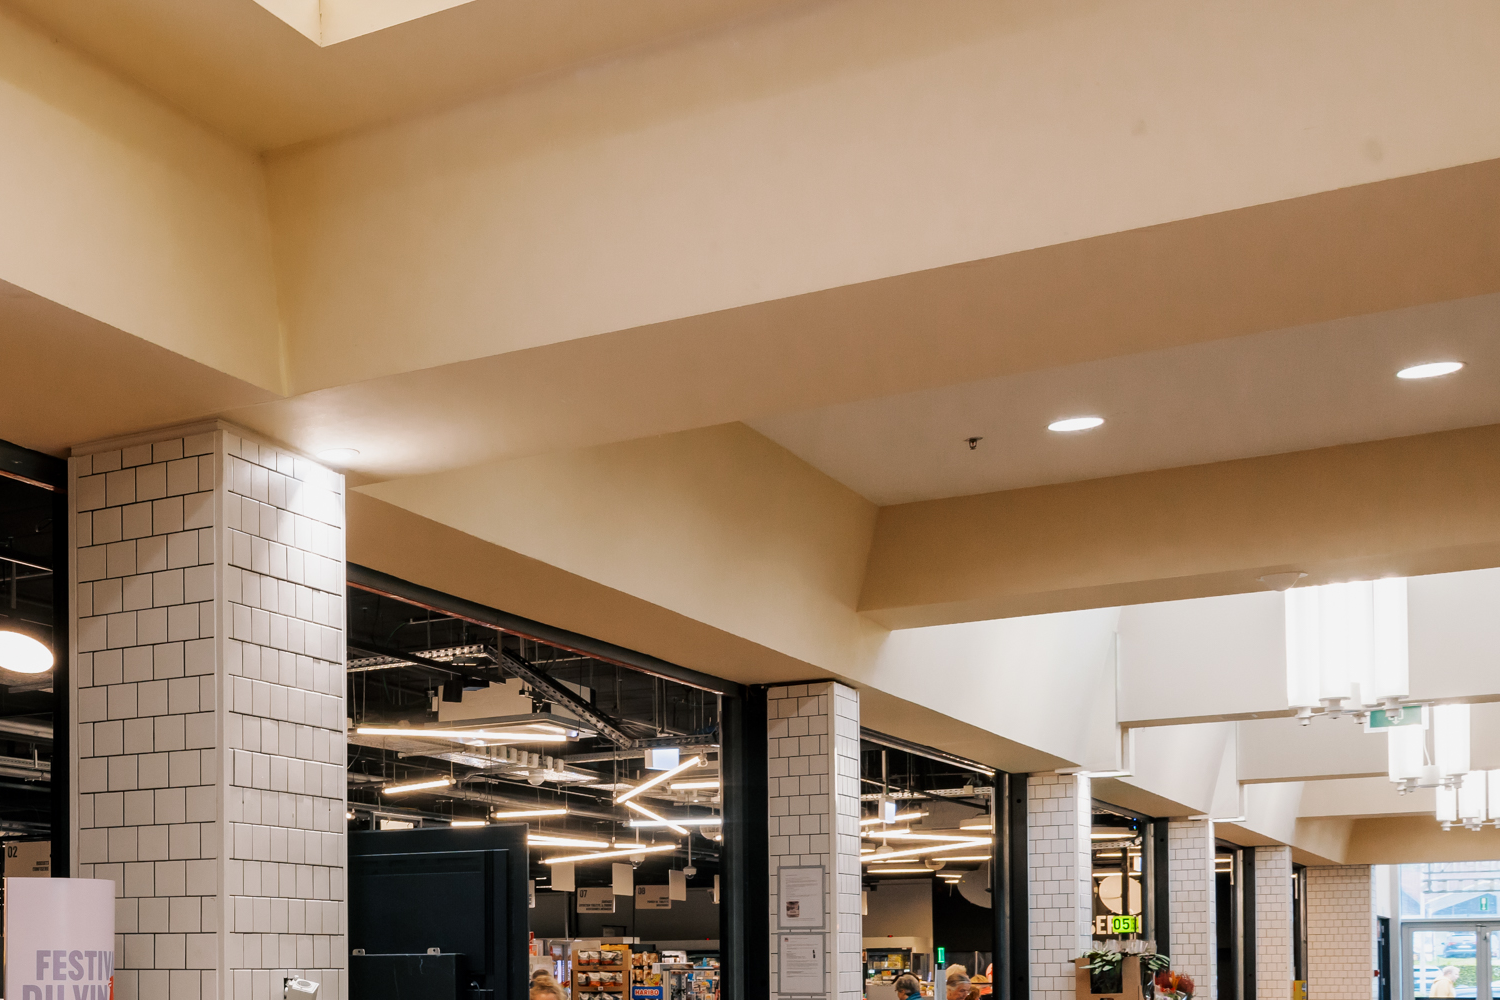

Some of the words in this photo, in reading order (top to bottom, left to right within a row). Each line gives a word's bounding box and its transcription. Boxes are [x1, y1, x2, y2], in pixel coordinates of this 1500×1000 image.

[7, 845, 18, 858] 02
[580, 890, 588, 898] 07
[1113, 918, 1130, 930] 05
